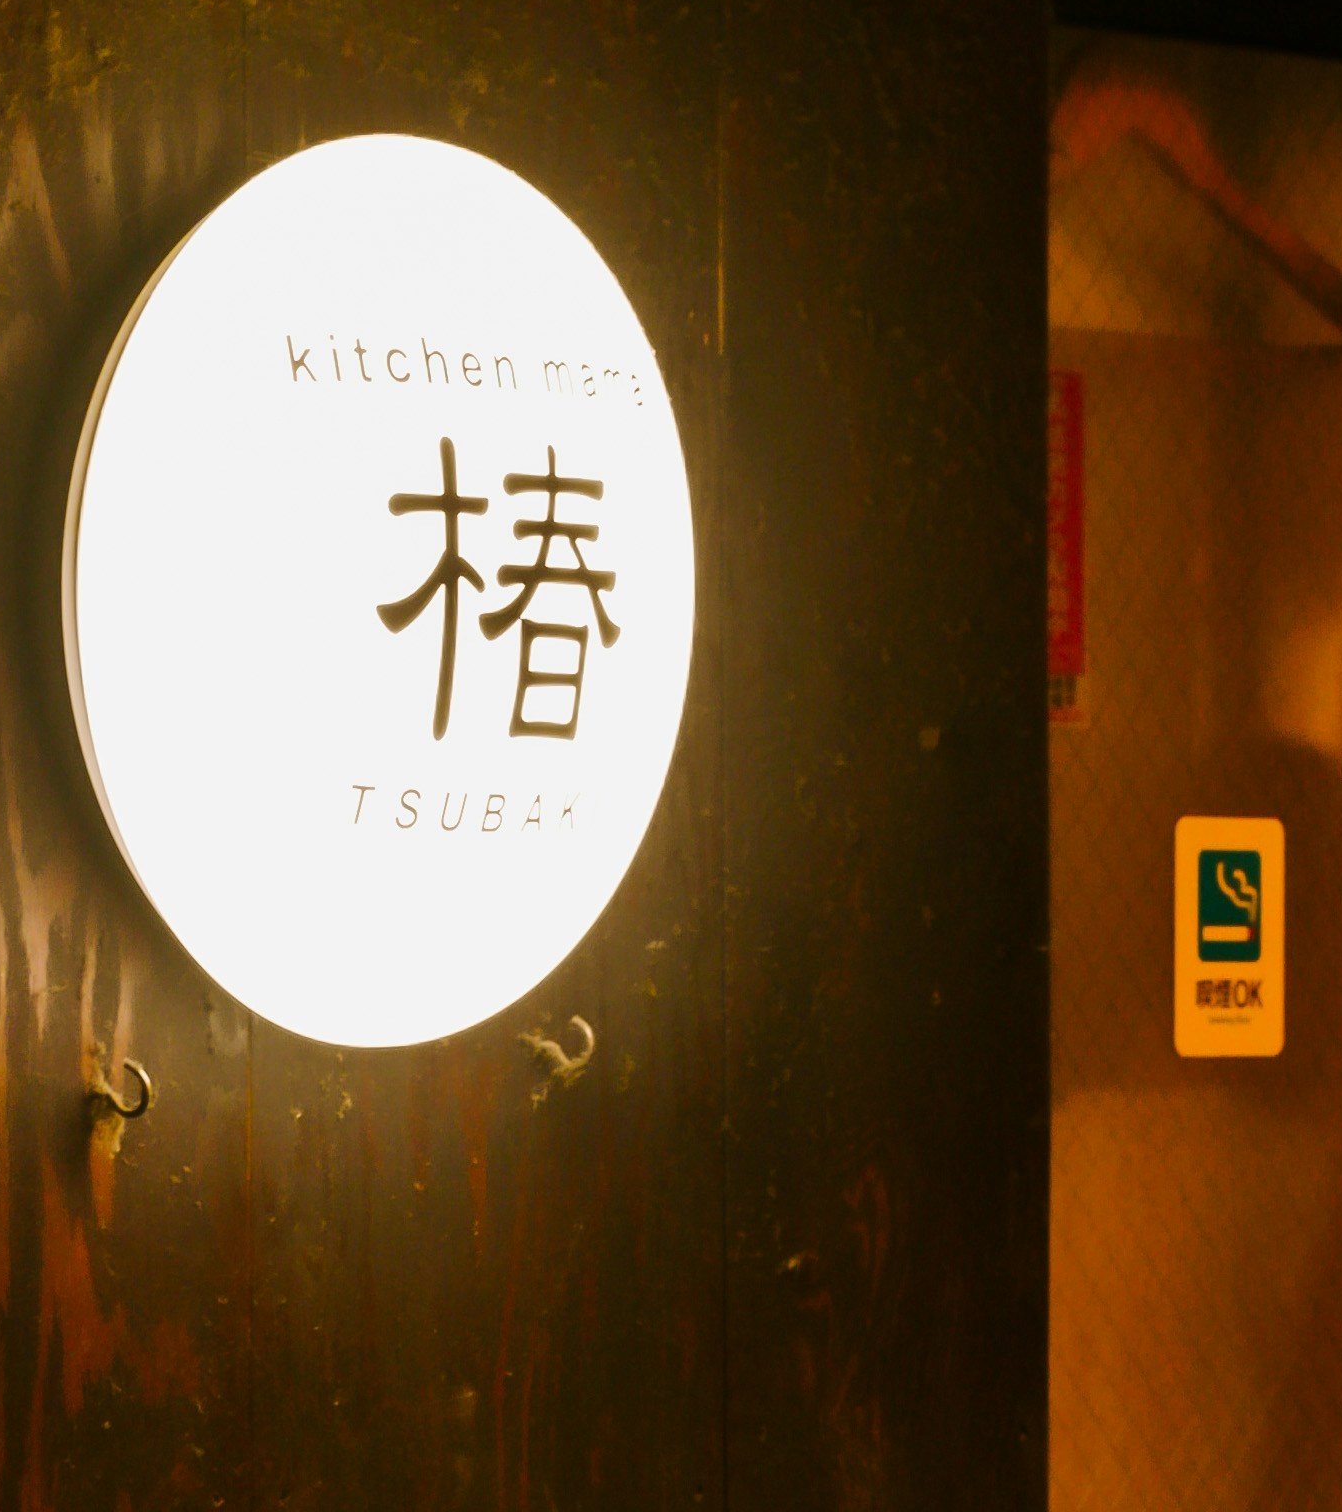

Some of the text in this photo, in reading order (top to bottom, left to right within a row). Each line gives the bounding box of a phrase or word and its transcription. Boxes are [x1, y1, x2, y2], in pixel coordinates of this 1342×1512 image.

[285, 334, 518, 391] kitchen
[375, 435, 623, 742] 椿
[351, 783, 591, 833] TSUBAK
